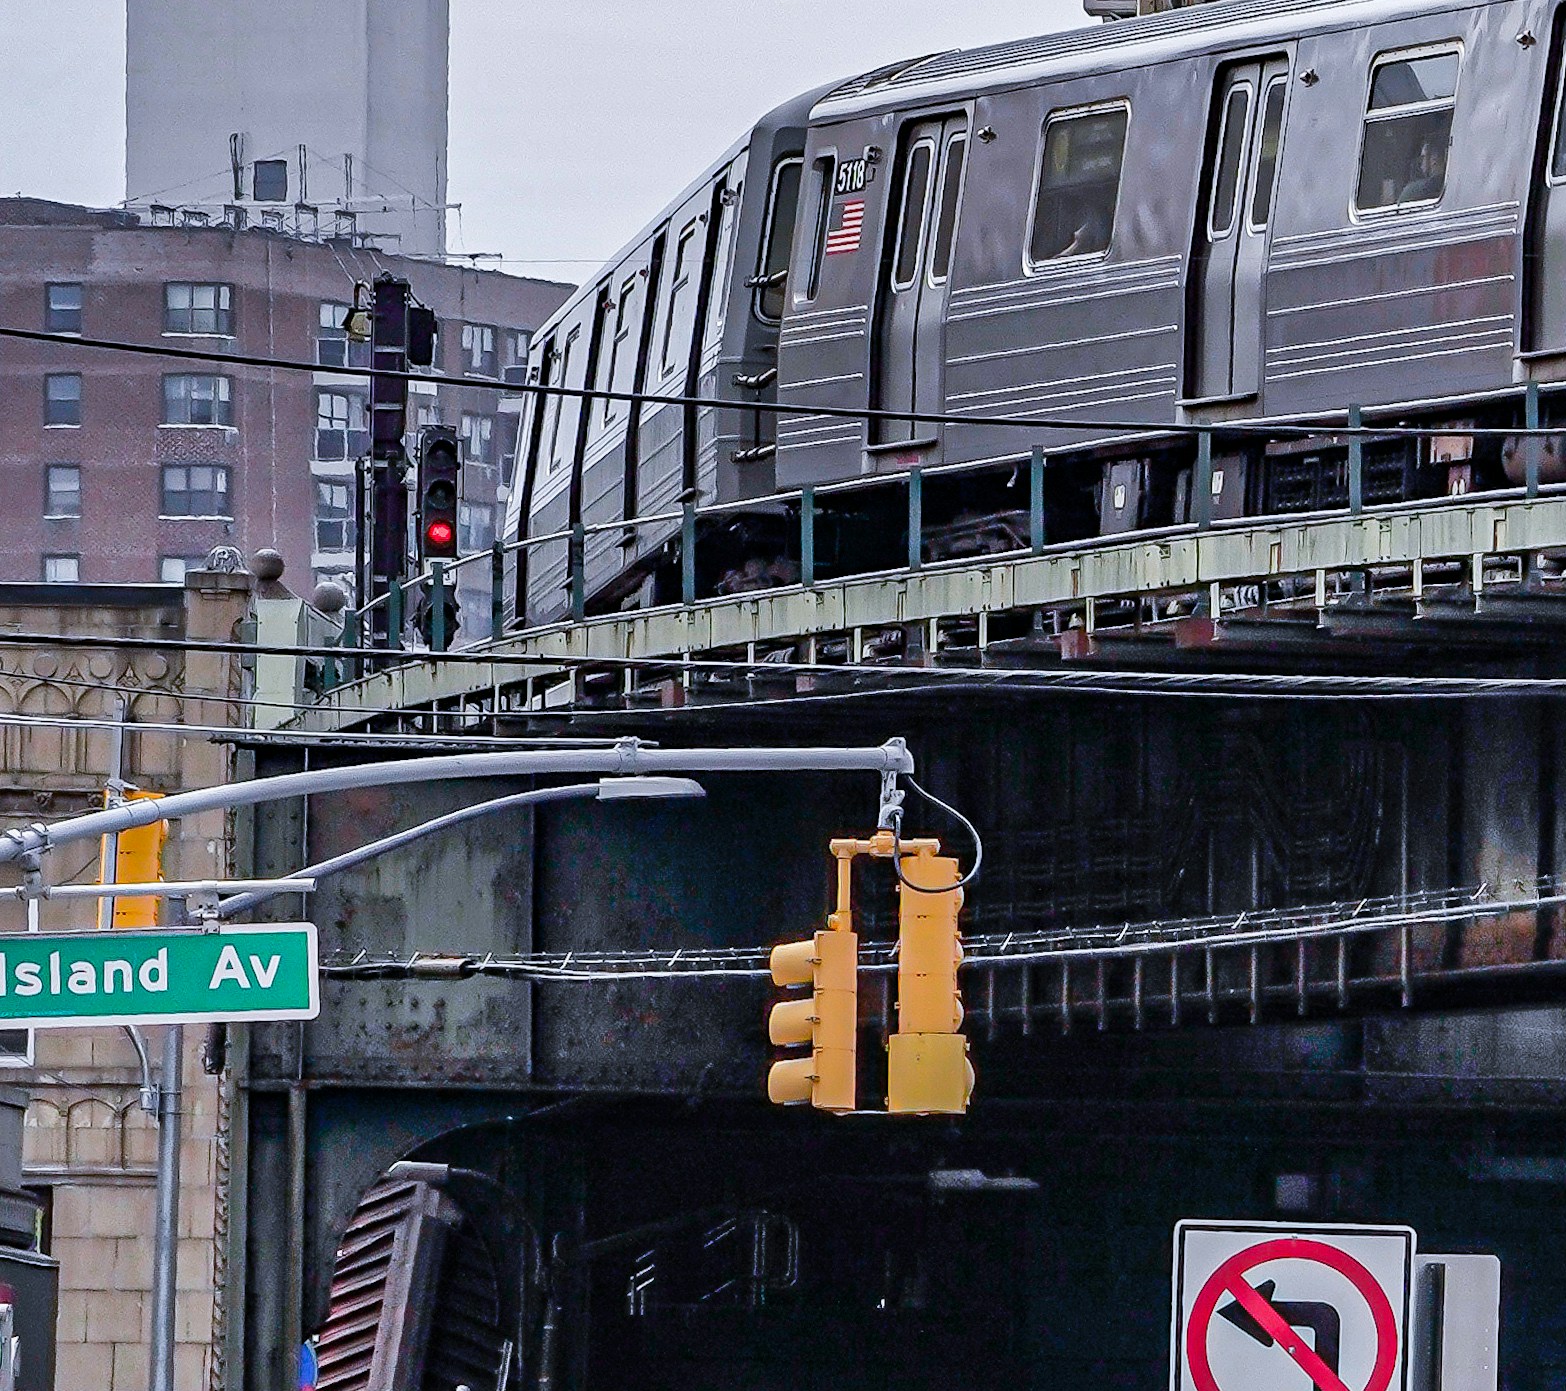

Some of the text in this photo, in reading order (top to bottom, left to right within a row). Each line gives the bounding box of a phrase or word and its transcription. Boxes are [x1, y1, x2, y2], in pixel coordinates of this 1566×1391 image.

[837, 159, 865, 192] 5118
[0, 944, 282, 997] Island Av
